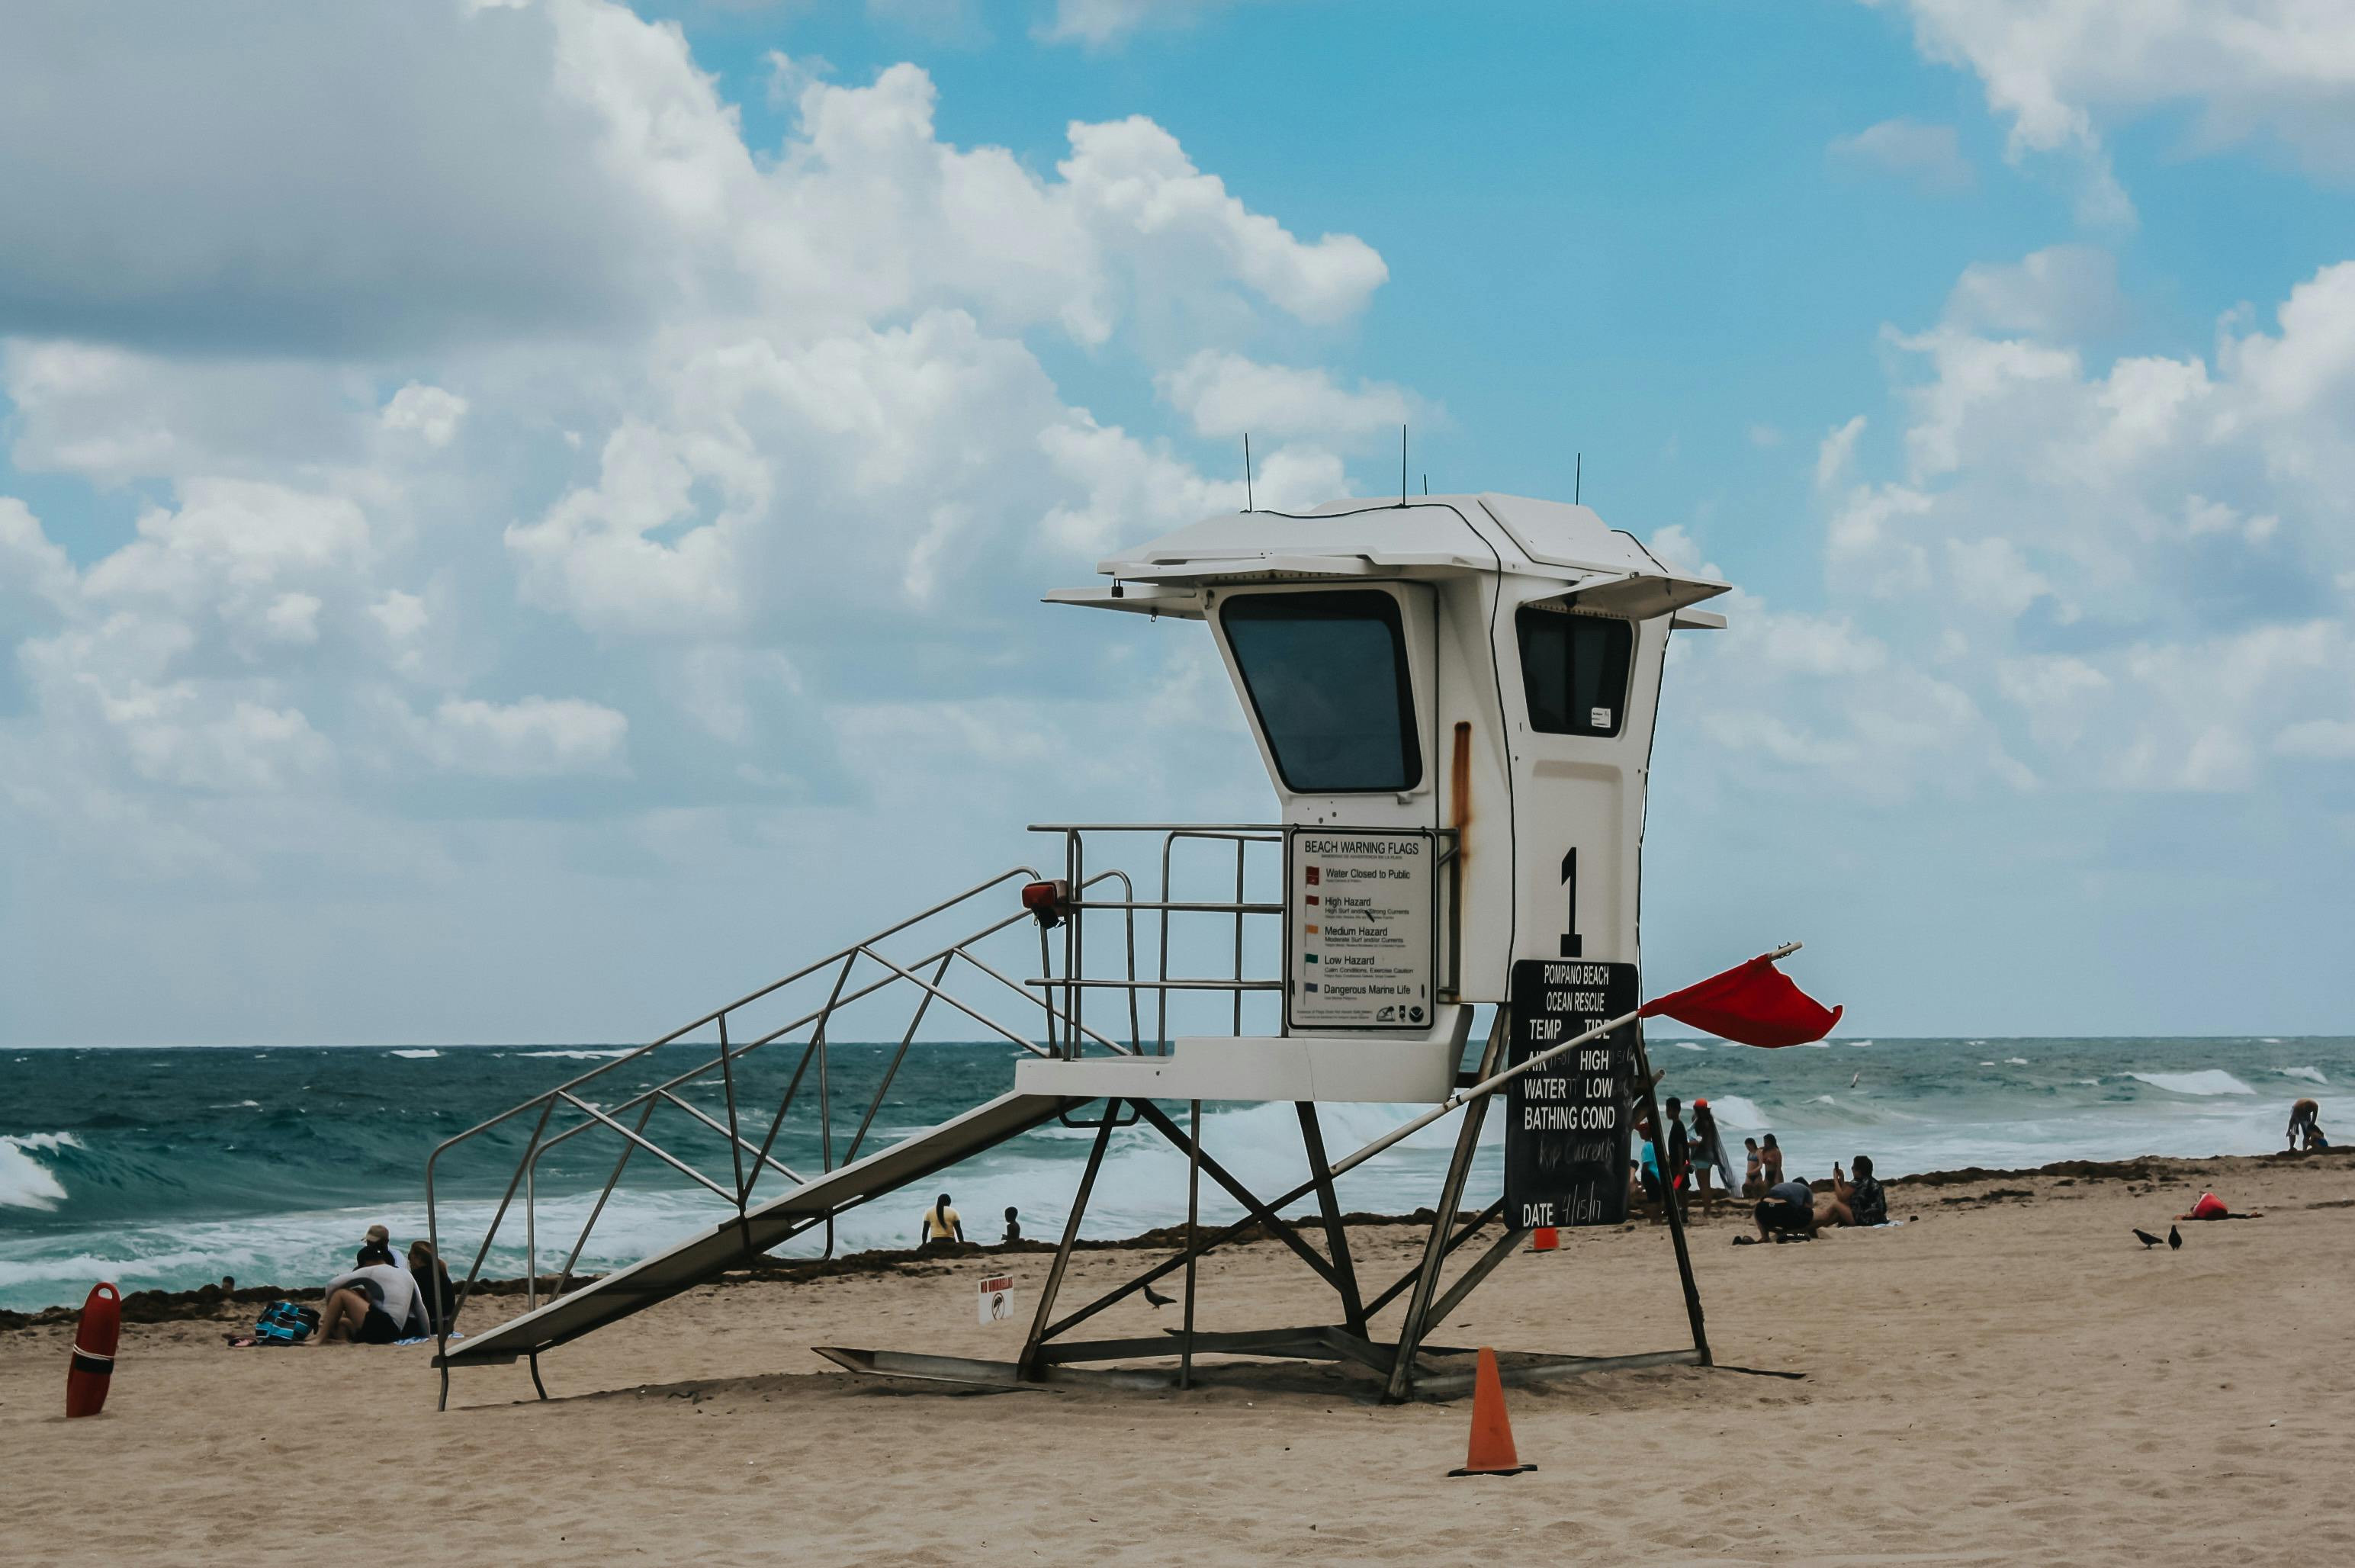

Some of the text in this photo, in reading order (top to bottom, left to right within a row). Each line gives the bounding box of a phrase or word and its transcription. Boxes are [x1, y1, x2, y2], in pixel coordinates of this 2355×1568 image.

[1305, 840, 1419, 855] BEACH WARNING FLAGS
[1325, 868, 1410, 879] Water Closed to Public
[1325, 897, 1371, 908] High Hazard
[1560, 847, 1582, 958] 1
[1325, 926, 1388, 937] Medium Hazard
[1324, 955, 1375, 966] Low Hazard
[1544, 965, 1609, 985] POMPANO BEACH
[1324, 984, 1411, 995] Dangerous Marine Life
[1547, 991, 1605, 1011] OCEAN RESCUE
[1529, 1019, 1562, 1039] TEMP
[1580, 1049, 1609, 1071] HIGH
[1524, 1078, 1566, 1099] WATER
[1586, 1078, 1613, 1098] LOW
[1524, 1107, 1615, 1129] BATHING COND
[1523, 1203, 1553, 1226] DATE
